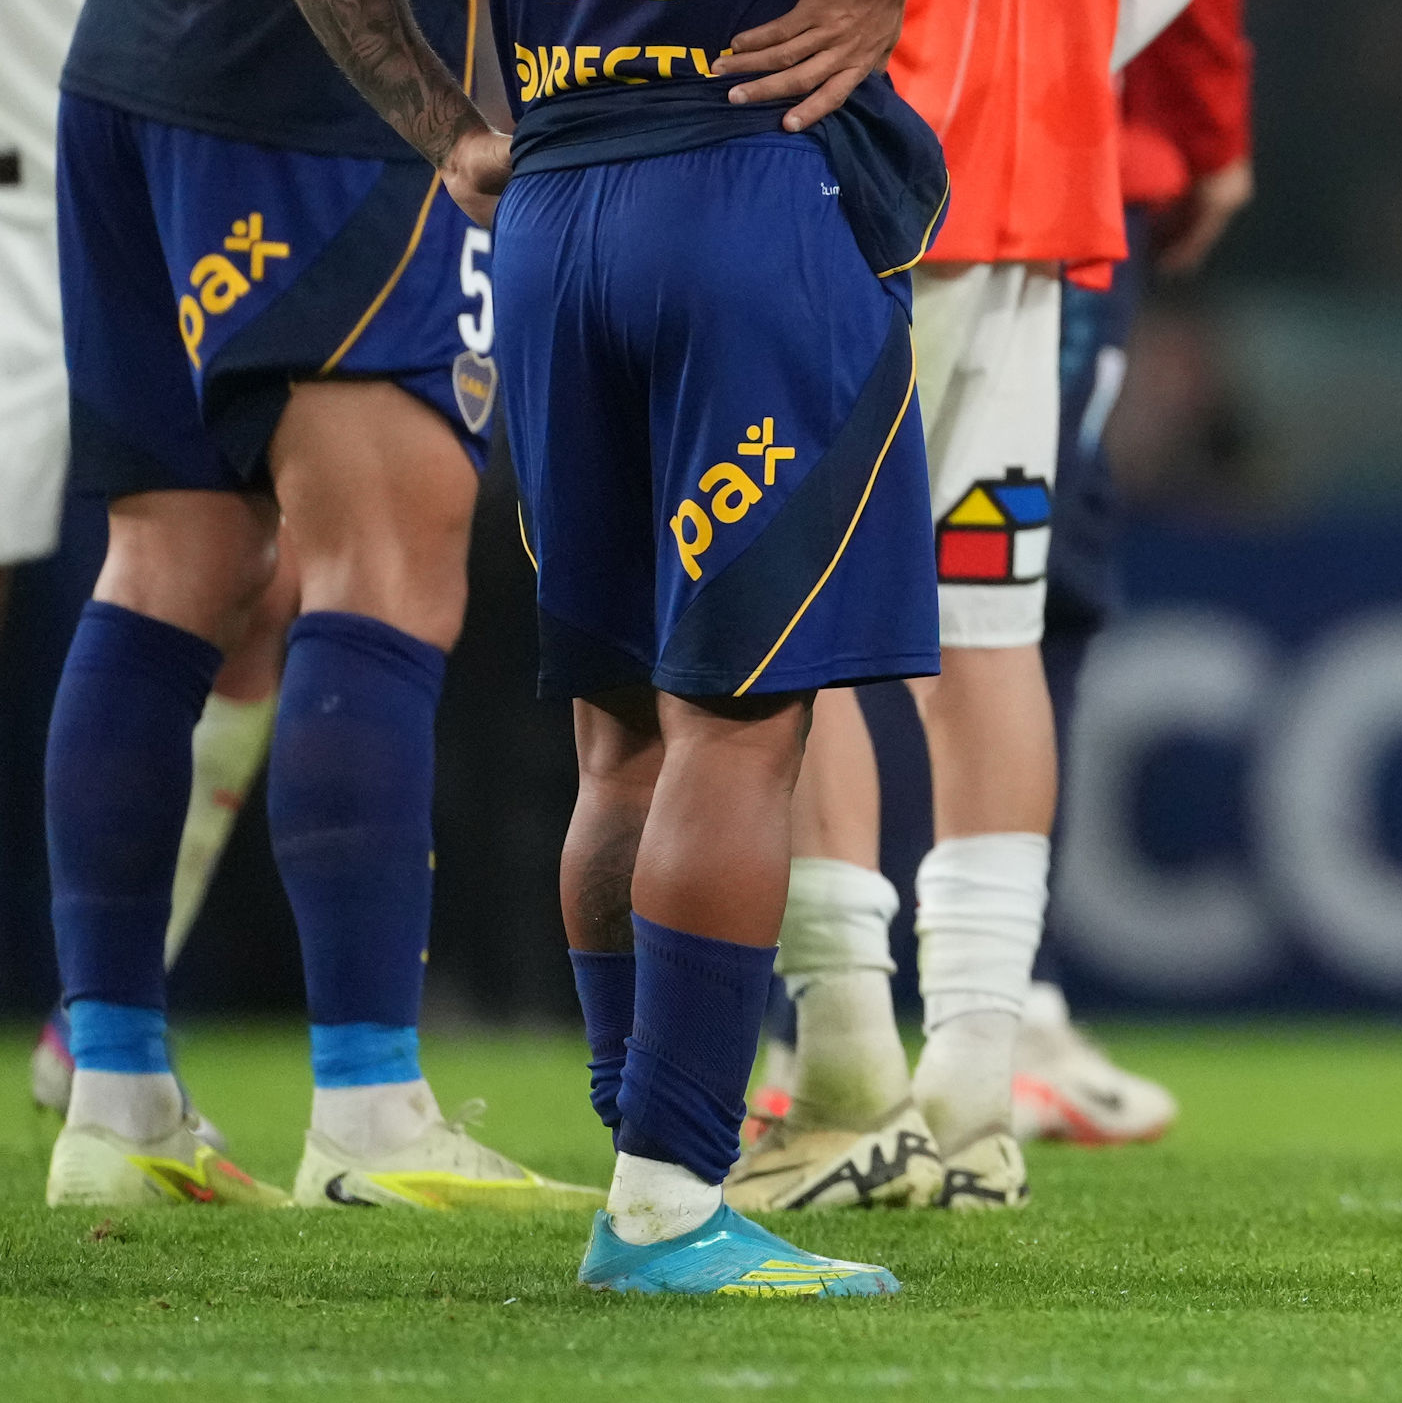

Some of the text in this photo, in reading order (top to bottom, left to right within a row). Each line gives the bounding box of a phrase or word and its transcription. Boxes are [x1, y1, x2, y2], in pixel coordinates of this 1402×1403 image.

[178, 212, 290, 368] pax
[457, 226, 495, 355] 5
[669, 416, 796, 581] pax
